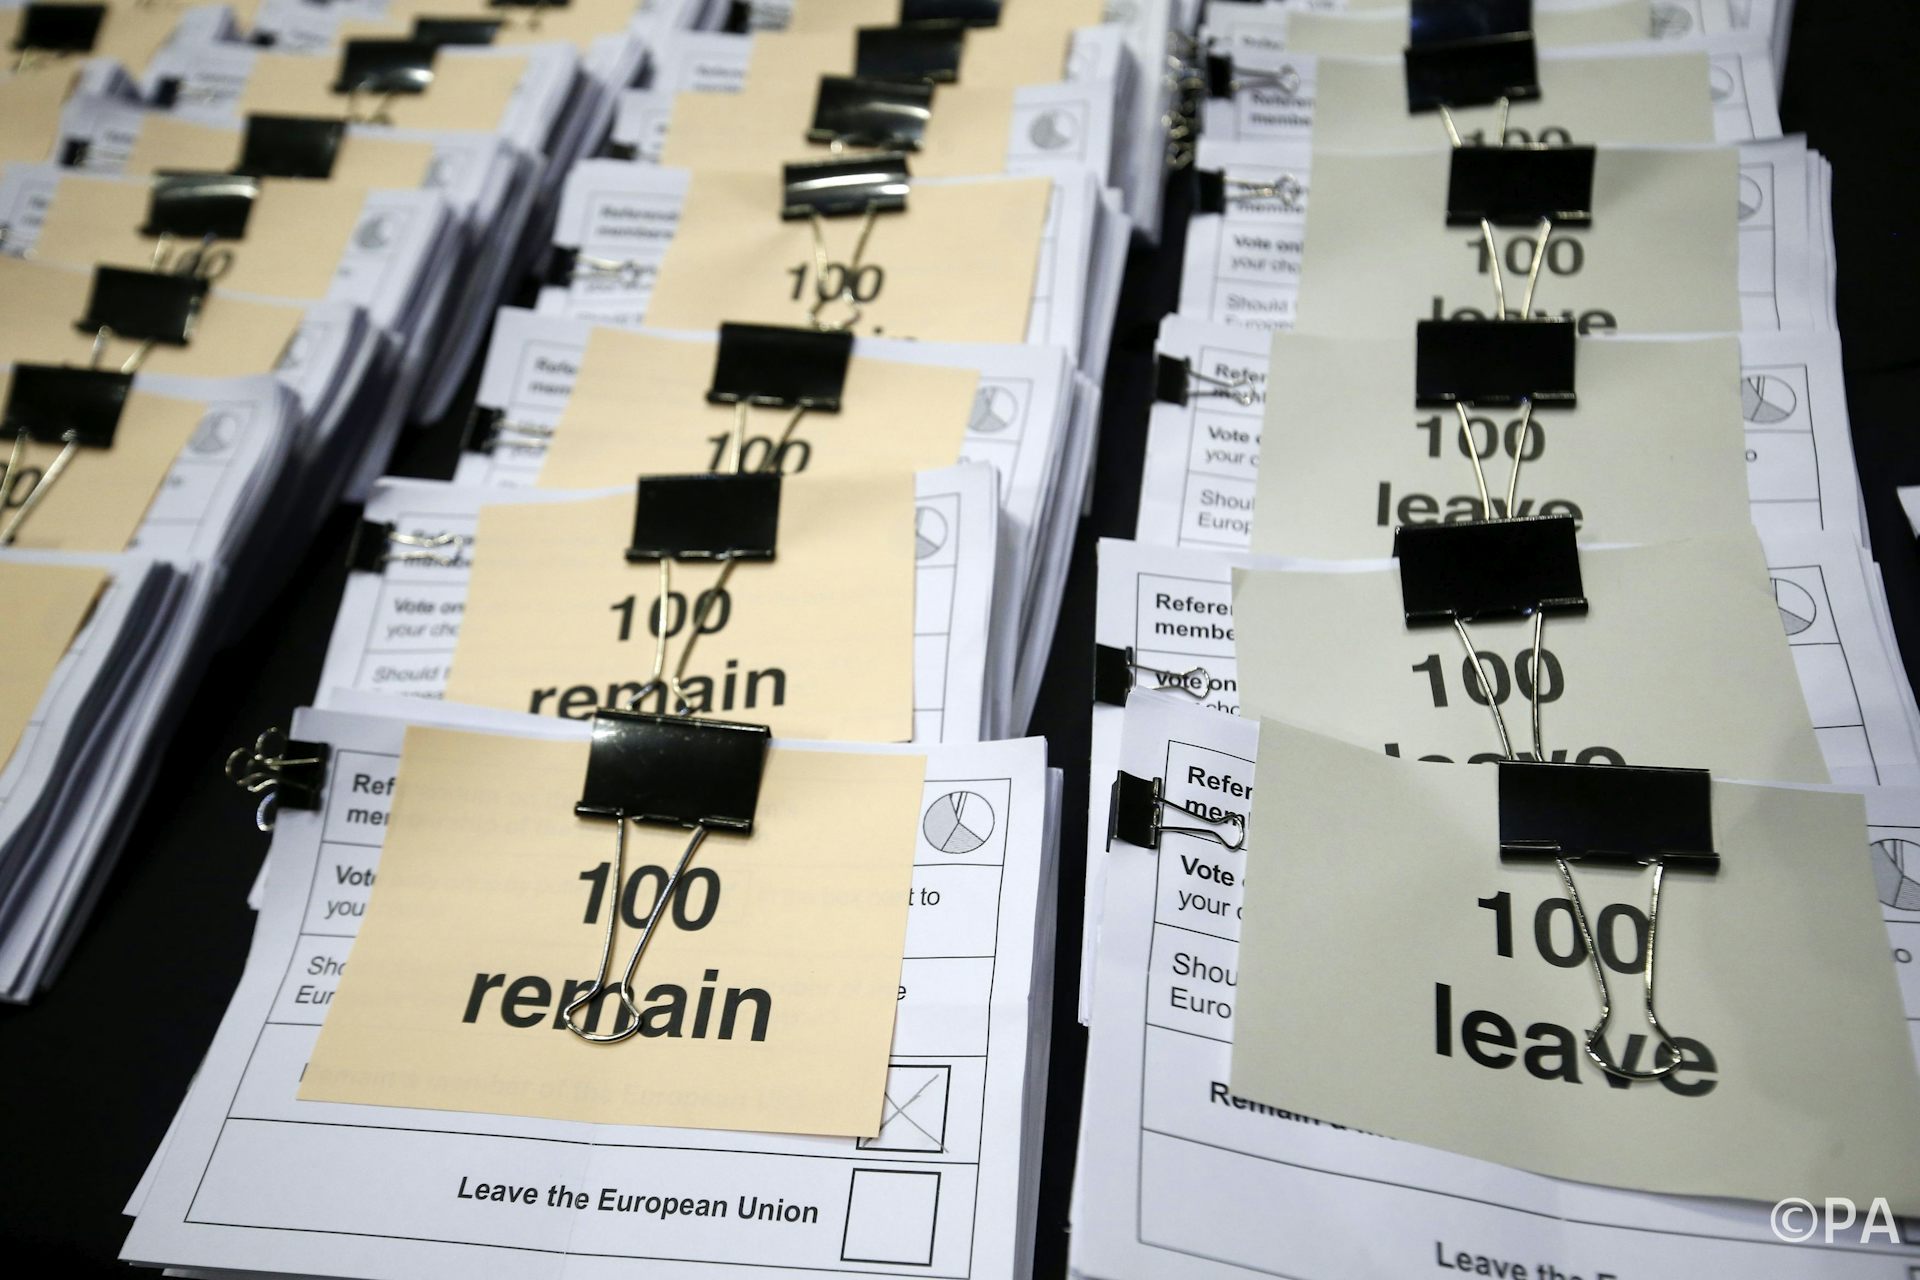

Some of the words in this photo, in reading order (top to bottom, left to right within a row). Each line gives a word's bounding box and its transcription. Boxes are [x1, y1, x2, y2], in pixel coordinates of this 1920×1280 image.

[1467, 234, 1585, 276] 100
[786, 261, 885, 303] 100
[708, 431, 812, 476] 100
[1208, 425, 1250, 443] Vote
[1416, 415, 1546, 462] 100
[1205, 449, 1245, 466] your
[610, 586, 732, 641] 100
[1156, 593, 1233, 616] Refere
[529, 659, 786, 722] remain
[1412, 648, 1565, 708] 100
[1181, 854, 1235, 887] Vote
[579, 861, 721, 931] 100
[920, 887, 940, 906] to
[1178, 889, 1231, 917] your
[1478, 890, 1651, 975] 100
[462, 968, 772, 1042] remain
[1435, 981, 1719, 1098] leave
[457, 1176, 539, 1206] Leave
[547, 1184, 590, 1210] the
[597, 1187, 728, 1221] European
[737, 1195, 820, 1225] Union
[1435, 1240, 1528, 1280] Leave
